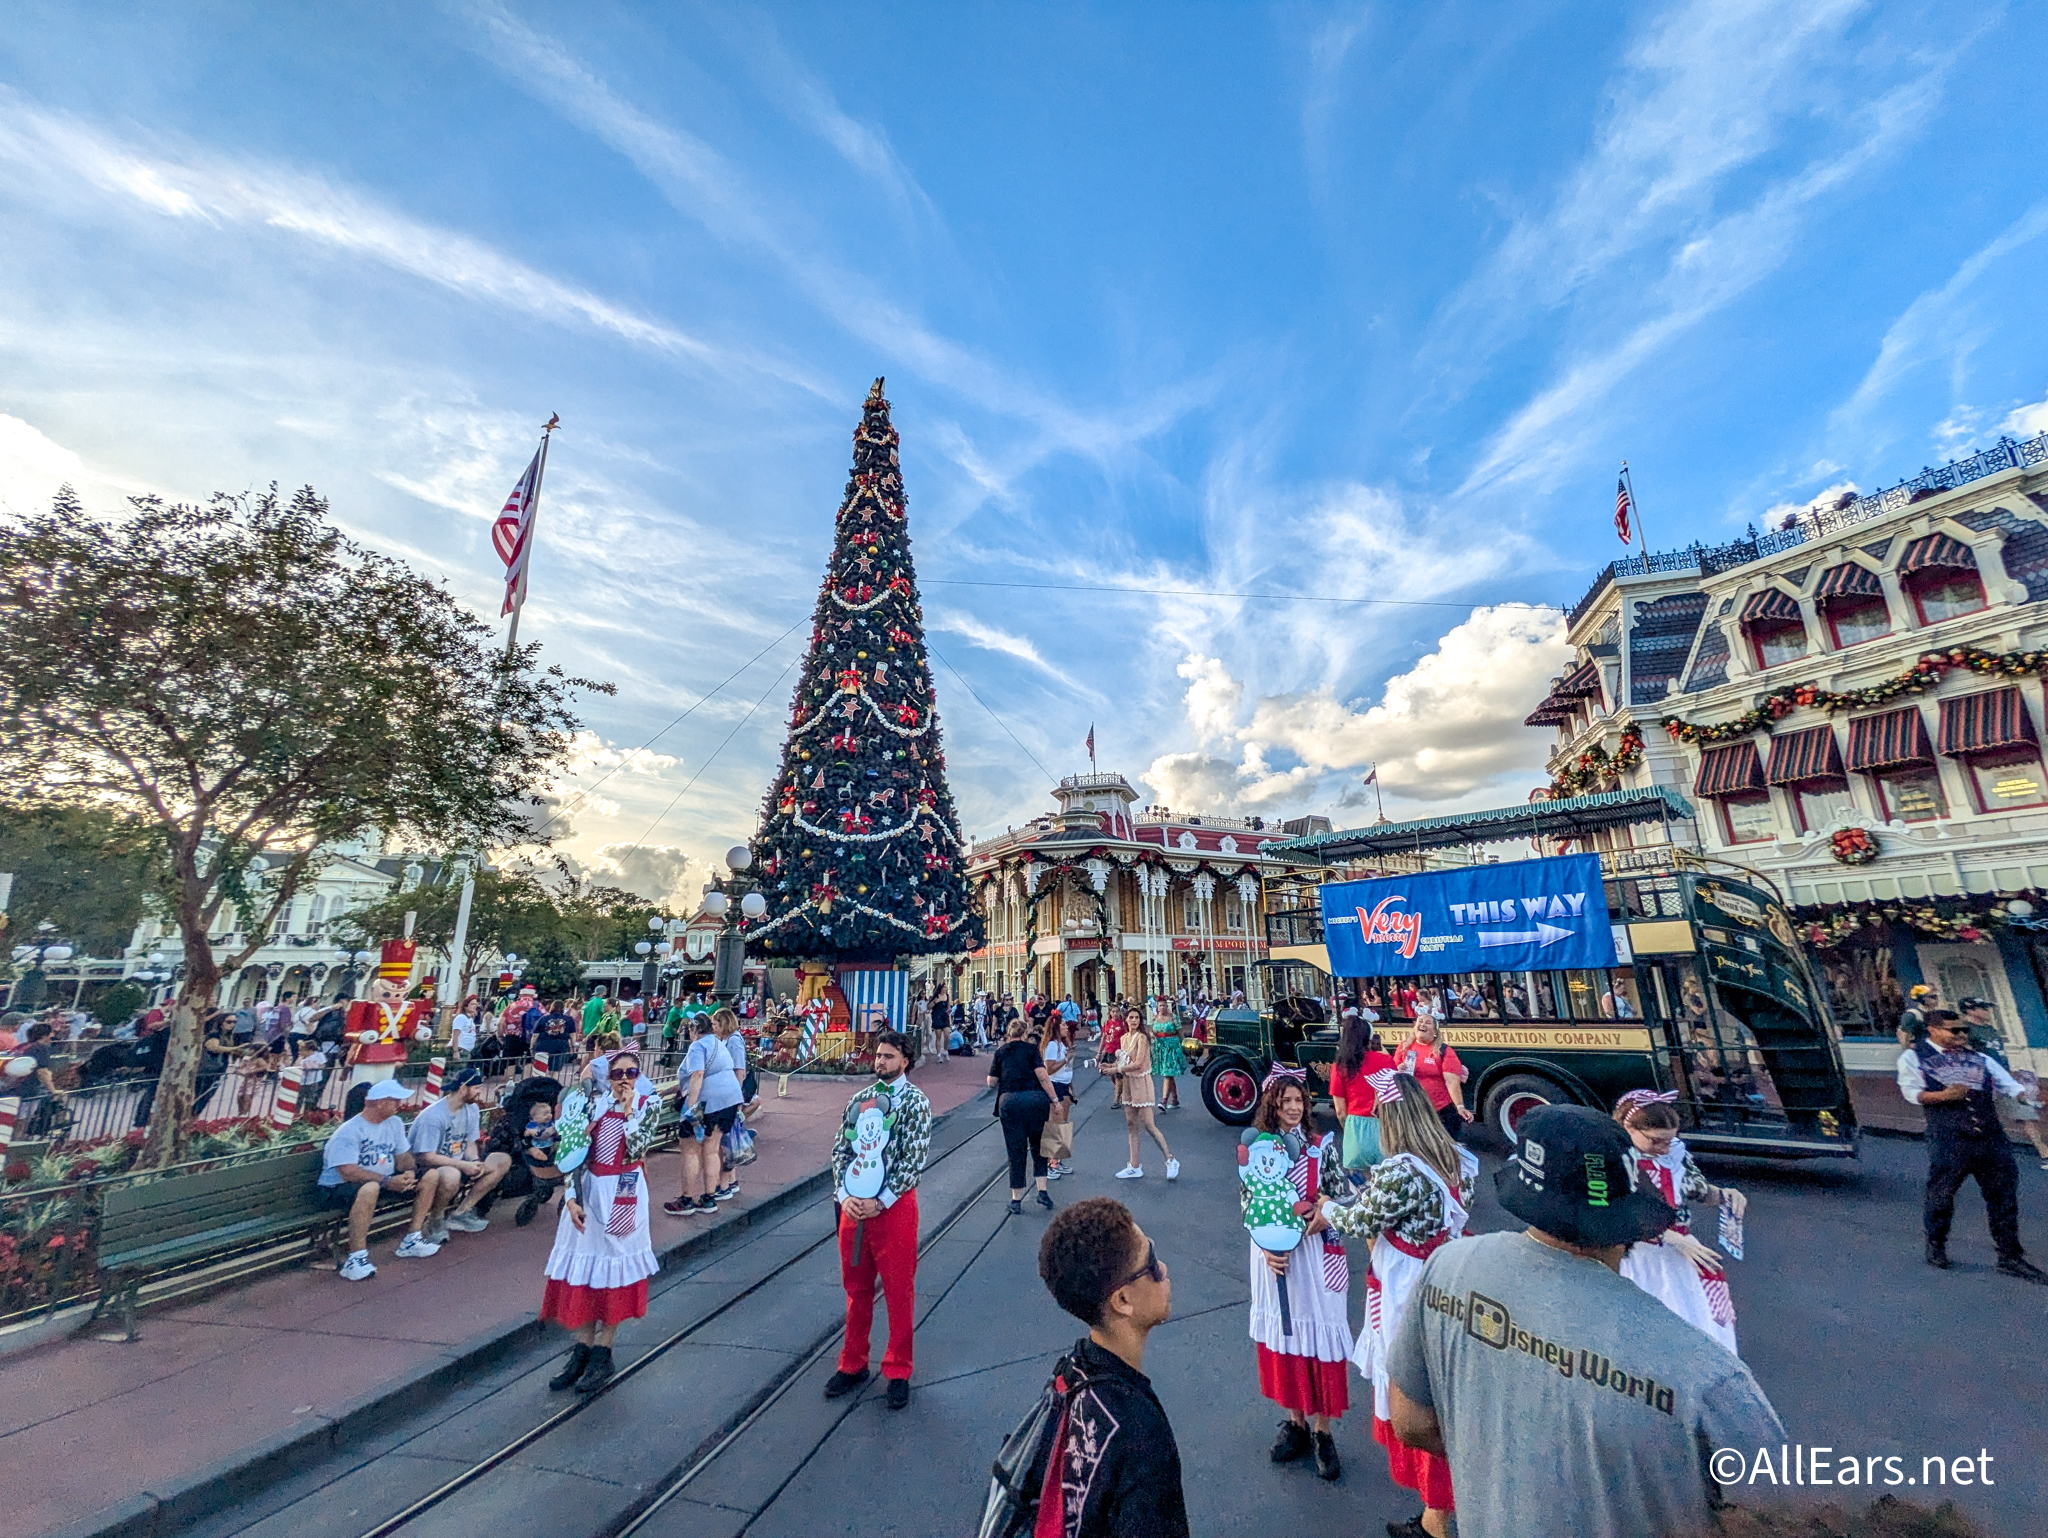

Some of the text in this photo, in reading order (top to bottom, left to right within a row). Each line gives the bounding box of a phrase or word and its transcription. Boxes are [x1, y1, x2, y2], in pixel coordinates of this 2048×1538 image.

[1449, 892, 1586, 926] THIS WAY
[1355, 895, 1422, 959] Very
[1419, 943, 1446, 953] PARTY
[1420, 935, 1464, 945] CHRISTMAS
[1441, 1031, 1547, 1044] TRANSPORTATION
[1554, 1032, 1621, 1045] COMPANY
[1423, 1283, 1675, 1416] Walt Disney World
